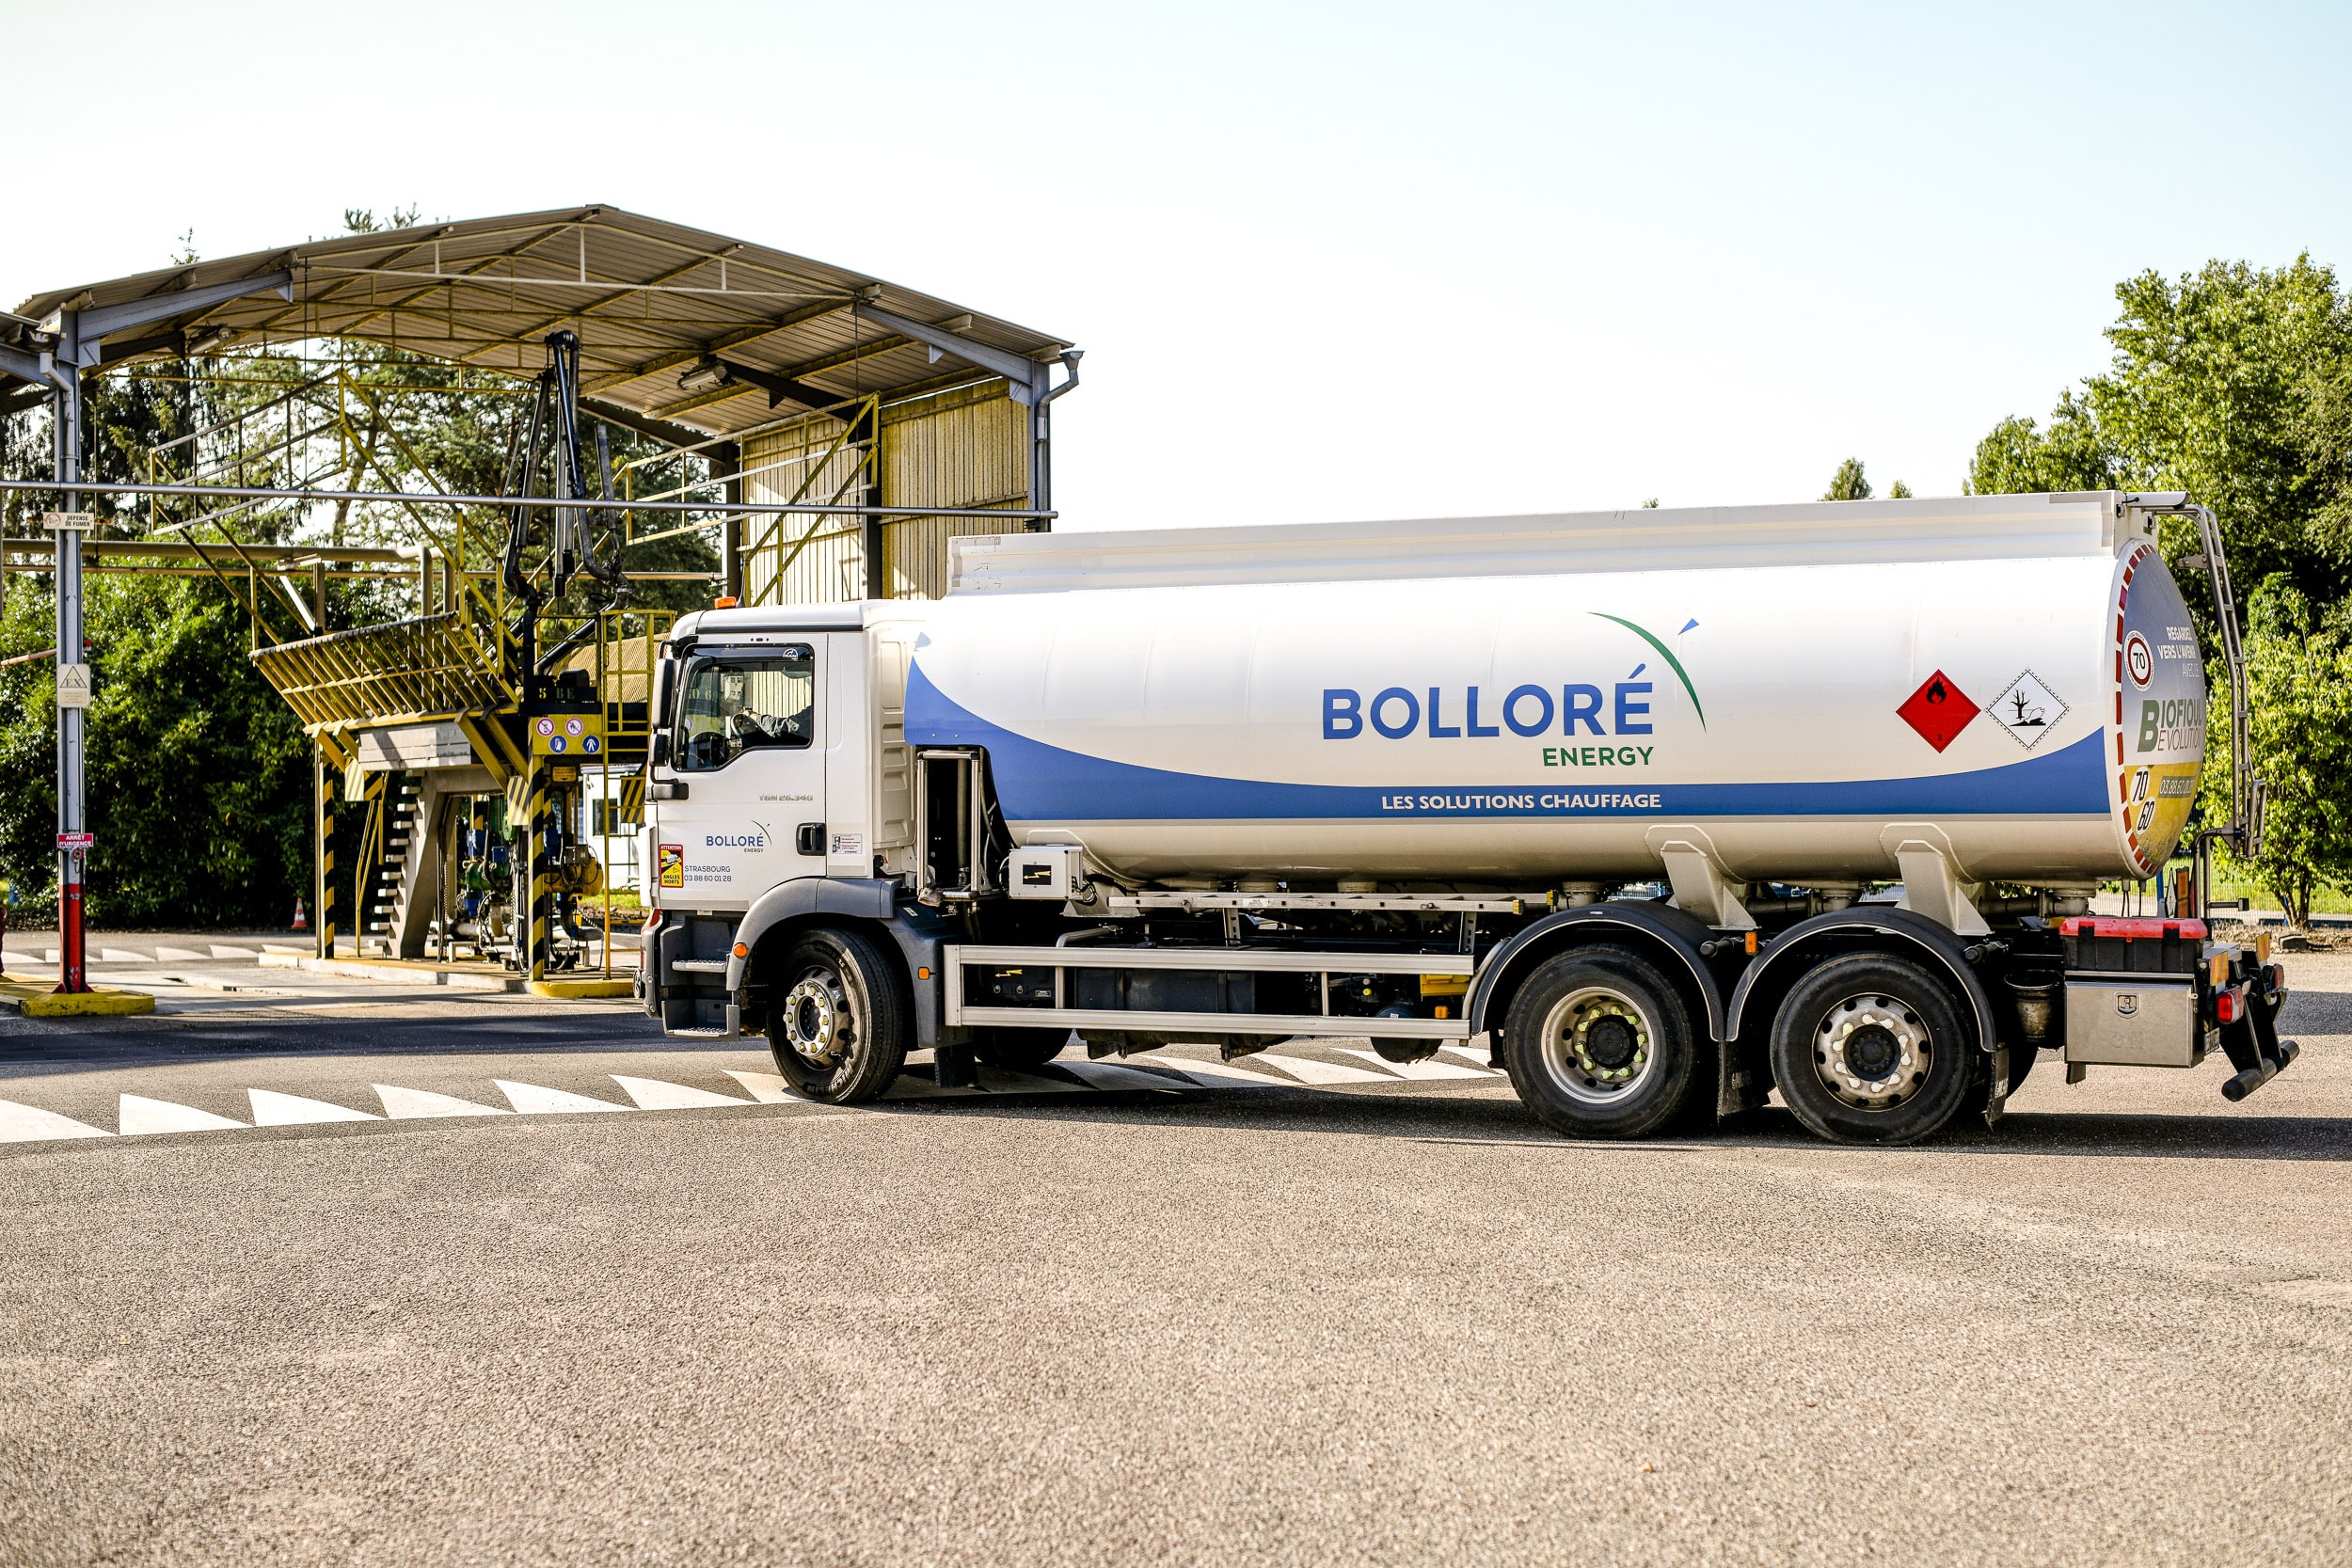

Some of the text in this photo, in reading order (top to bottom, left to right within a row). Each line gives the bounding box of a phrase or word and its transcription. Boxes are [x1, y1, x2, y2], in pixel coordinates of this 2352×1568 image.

[2157, 644, 2177, 659] VERS
[2133, 652, 2146, 669] 70
[67, 678, 82, 687] EX
[539, 688, 547, 699] 5
[1323, 663, 1653, 739] BOLLORÉ
[1543, 747, 1653, 767] ENERGY
[2132, 770, 2149, 801] 70
[1382, 793, 1663, 810] LES SOLUTIONS CHAUFFAGE
[2137, 800, 2155, 831] 60
[706, 832, 764, 847] BOLLORÉ
